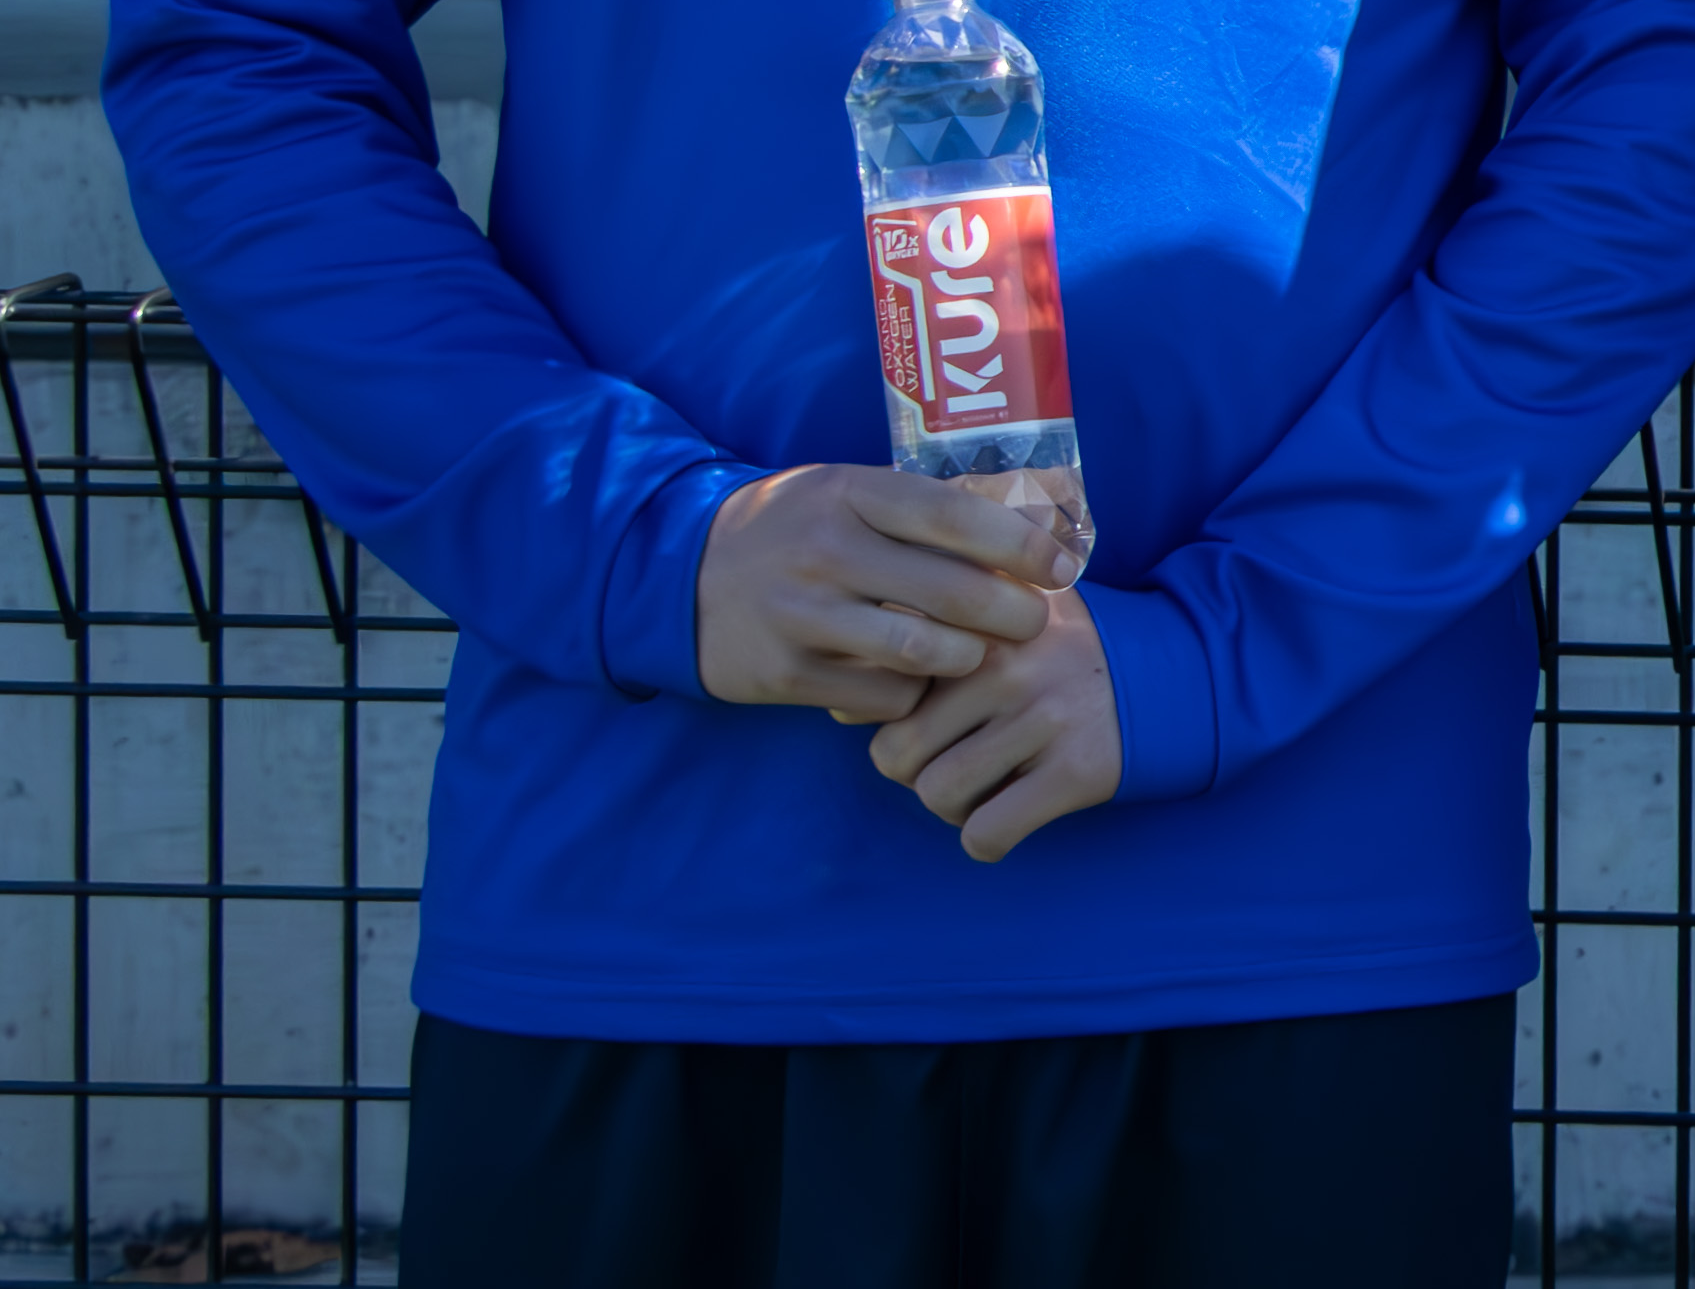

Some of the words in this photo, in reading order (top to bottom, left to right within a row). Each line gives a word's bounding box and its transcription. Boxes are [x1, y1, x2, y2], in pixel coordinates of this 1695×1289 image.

[877, 298, 893, 371] NANO
[885, 282, 906, 388] OXYGEN
[899, 305, 920, 394] WATER
